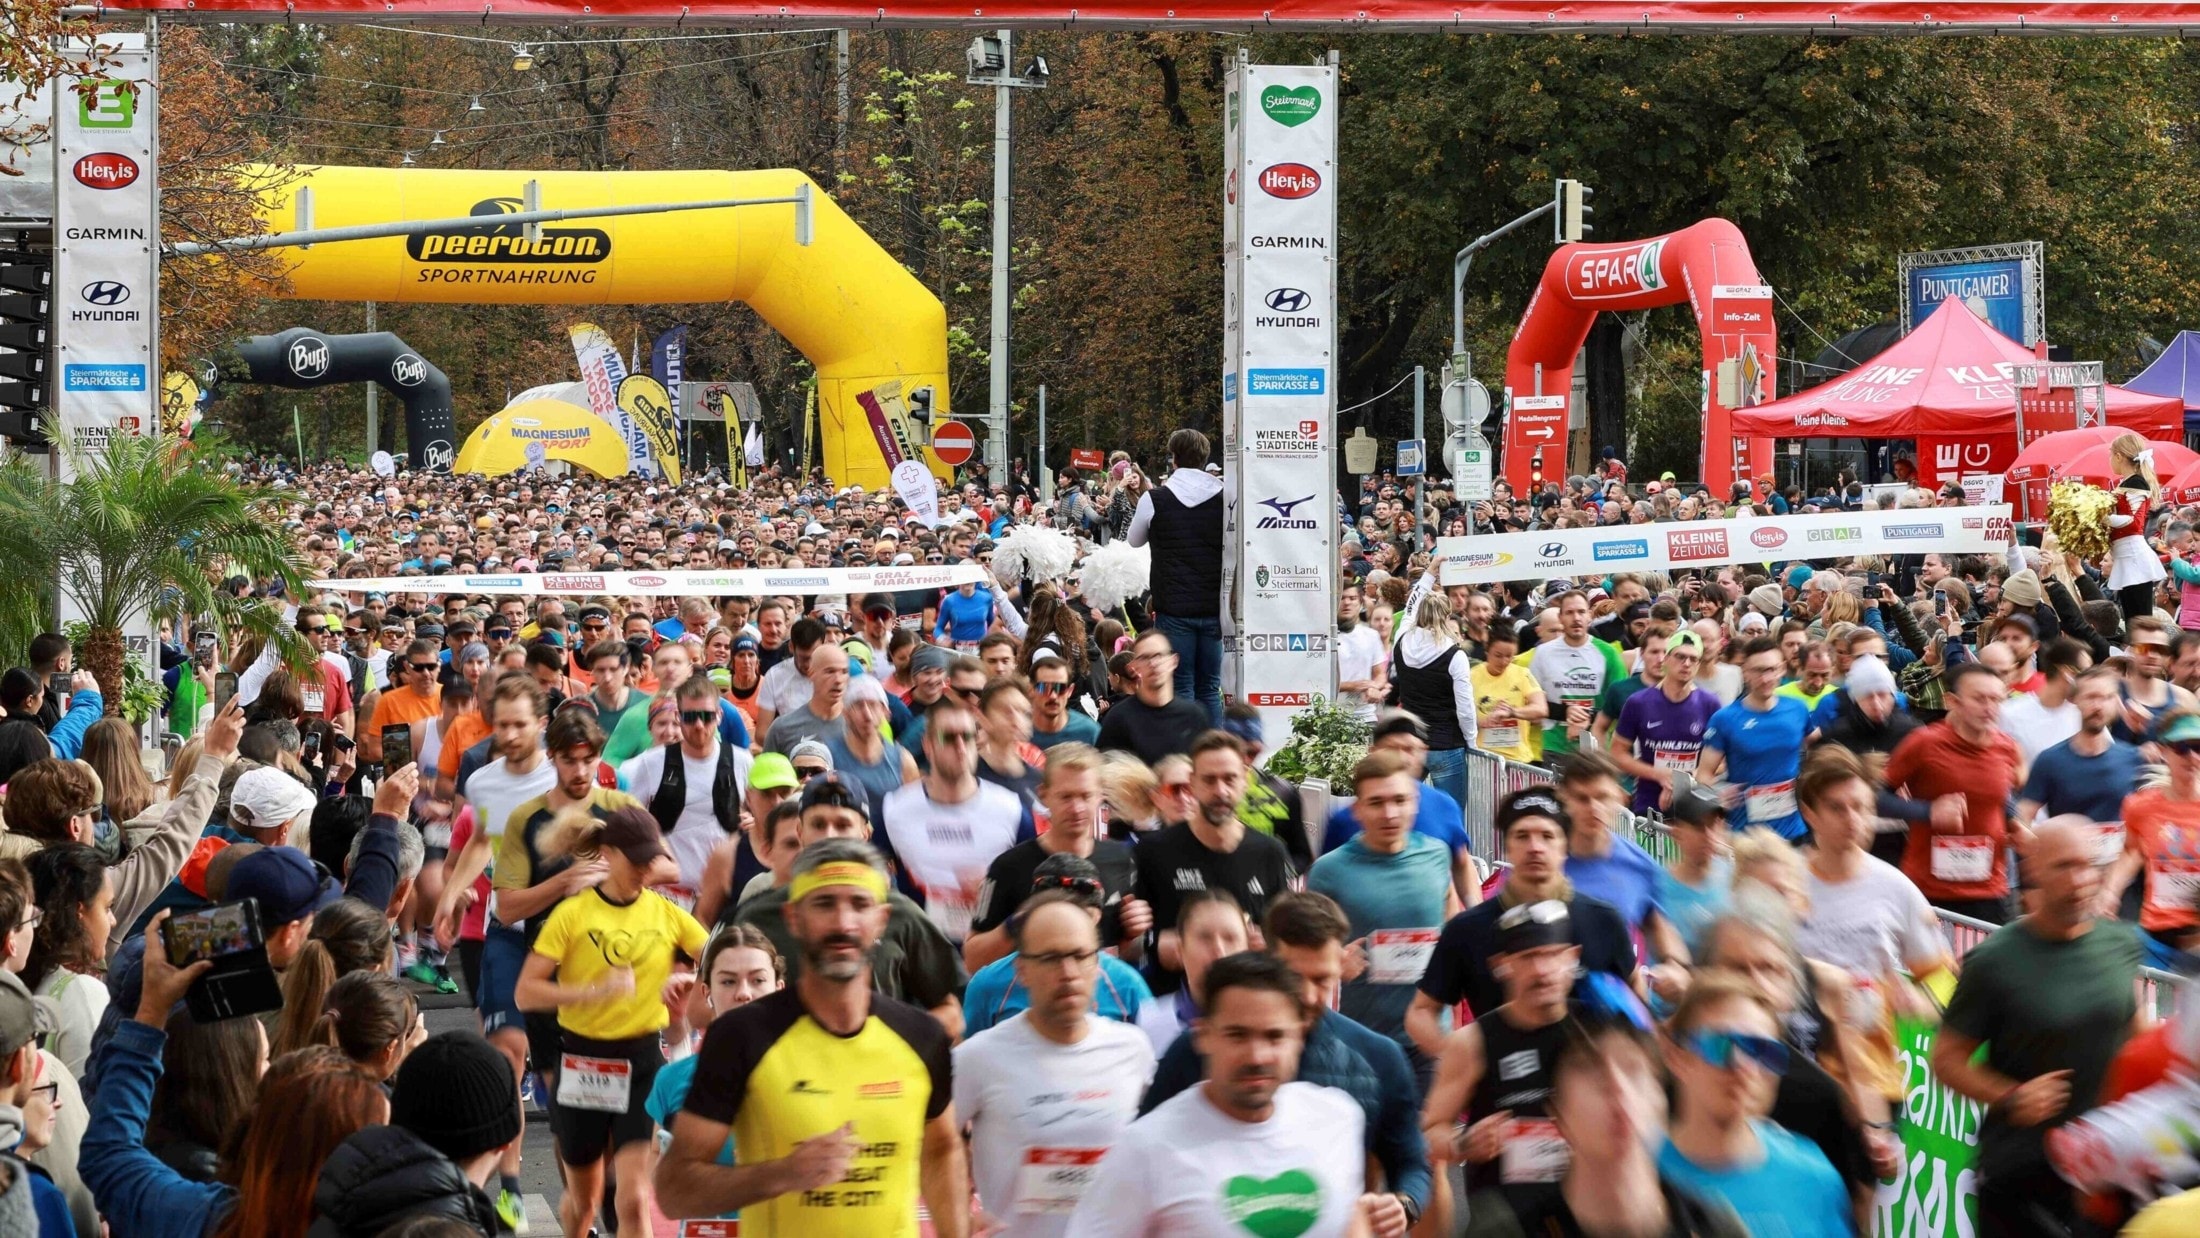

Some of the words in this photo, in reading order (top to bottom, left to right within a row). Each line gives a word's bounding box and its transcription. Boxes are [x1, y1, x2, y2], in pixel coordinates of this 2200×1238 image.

[1265, 95, 1317, 110] Steiermark
[80, 160, 134, 182] Hervis
[1265, 171, 1316, 192] Hervis
[417, 268, 597, 285] SPORTNAHRUNG
[1580, 254, 1638, 290] SPAR
[1922, 273, 2010, 301] PUNTIGAMER
[72, 311, 140, 322] HYUNDAI
[1723, 312, 1761, 321] Info-Zelt
[1256, 317, 1320, 328] HYUNDAI
[70, 377, 129, 386] SPARKASSE
[1253, 381, 1309, 390] SPARKASSE
[1794, 414, 1820, 426] Meine
[511, 426, 591, 440] MAGNESIUM
[1256, 430, 1298, 439] WIENER
[539, 437, 591, 450] SPORT
[1256, 439, 1318, 450] STÄDTISCHE
[1256, 517, 1317, 529] MIZUNO
[1986, 516, 2010, 529] GRA
[1753, 531, 1785, 544] Hervis
[1808, 528, 1861, 541] GRAZ
[1887, 526, 1940, 538] PUNTIGAMER
[1670, 531, 1724, 546] KLEINE
[1597, 547, 1638, 557] SPARKASSE
[1671, 541, 1726, 558] ZEITUNG
[1449, 553, 1494, 563] MAGNESIUM
[1534, 559, 1575, 568] HYUNDAI
[1469, 560, 1494, 568] SPORT
[873, 571, 912, 579] GRAZ
[1273, 565, 1291, 575] Das
[1295, 565, 1319, 575] Land
[545, 576, 602, 584] KLEINE
[873, 576, 953, 586] MARATHON
[1271, 580, 1319, 589] Steiermark
[544, 582, 603, 591] ZEITUNG
[1252, 635, 1324, 650] GRAZ
[1260, 695, 1308, 704] SPAR
